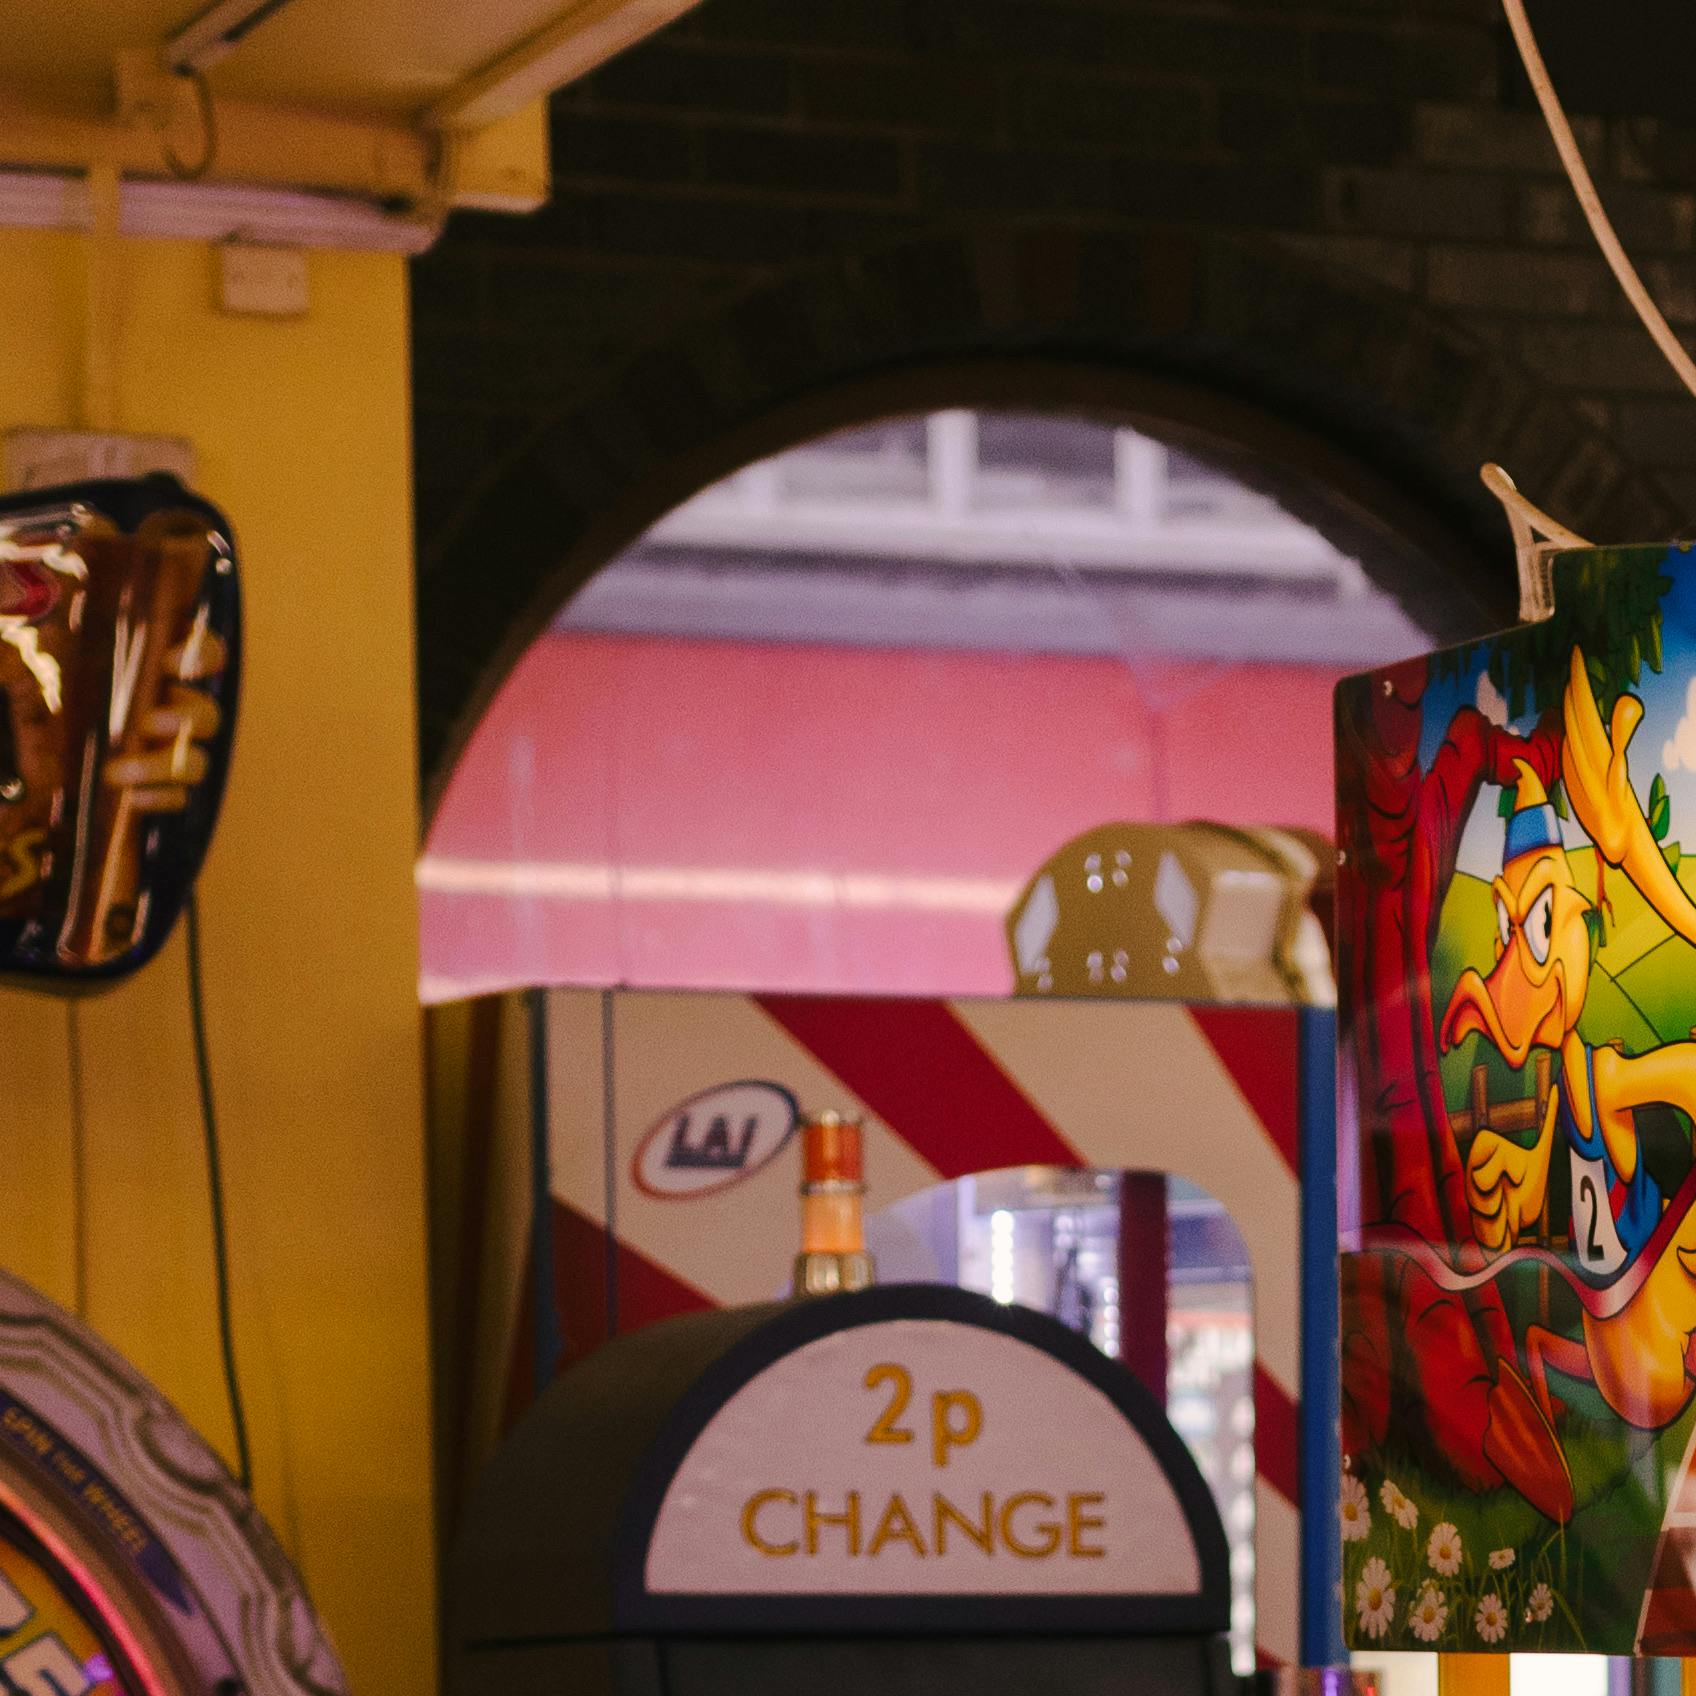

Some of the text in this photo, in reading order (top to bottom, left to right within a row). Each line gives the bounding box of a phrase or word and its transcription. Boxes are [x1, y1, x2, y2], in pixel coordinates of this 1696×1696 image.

[1579, 1174, 1607, 1263] 2
[863, 1362, 986, 1469] 2p
[740, 1486, 1108, 1560] CHANGE
